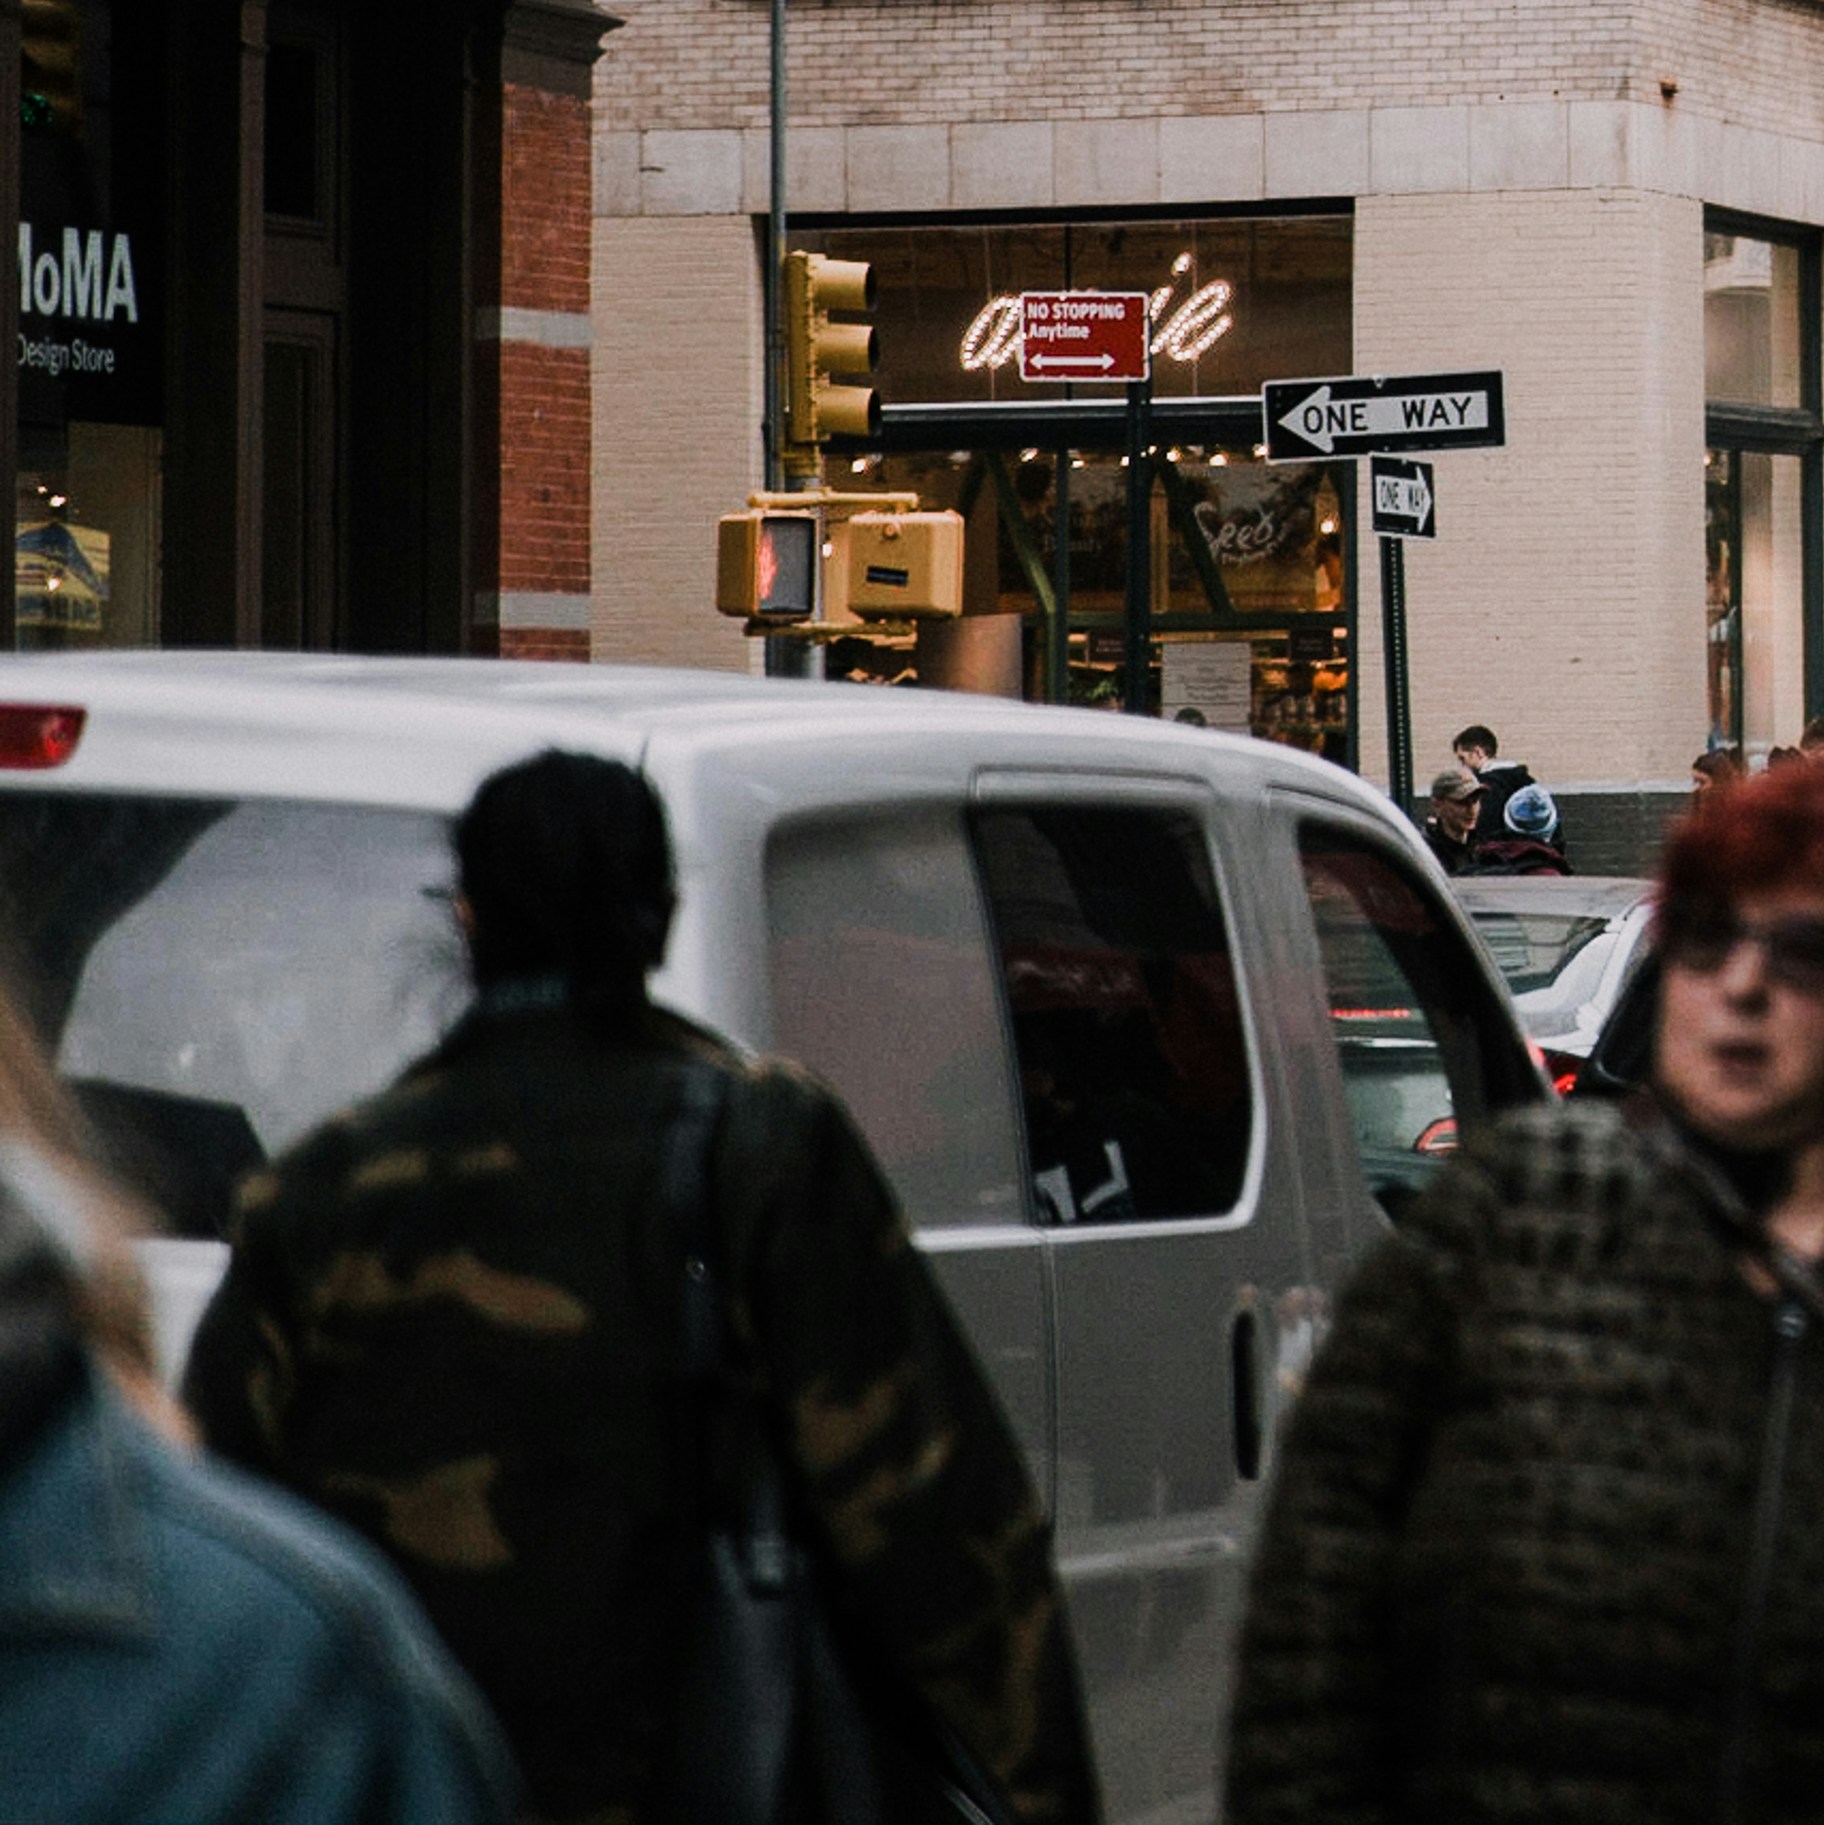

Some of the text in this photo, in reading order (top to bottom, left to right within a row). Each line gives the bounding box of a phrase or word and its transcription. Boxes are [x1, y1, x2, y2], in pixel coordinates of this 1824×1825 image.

[960, 251, 1233, 371] aie
[1027, 301, 1126, 321] NO STOPPING
[1029, 323, 1090, 342] Anytime
[71, 338, 116, 375] Store
[1303, 396, 1472, 435] ONE WAY
[1380, 480, 1400, 511] ONE
